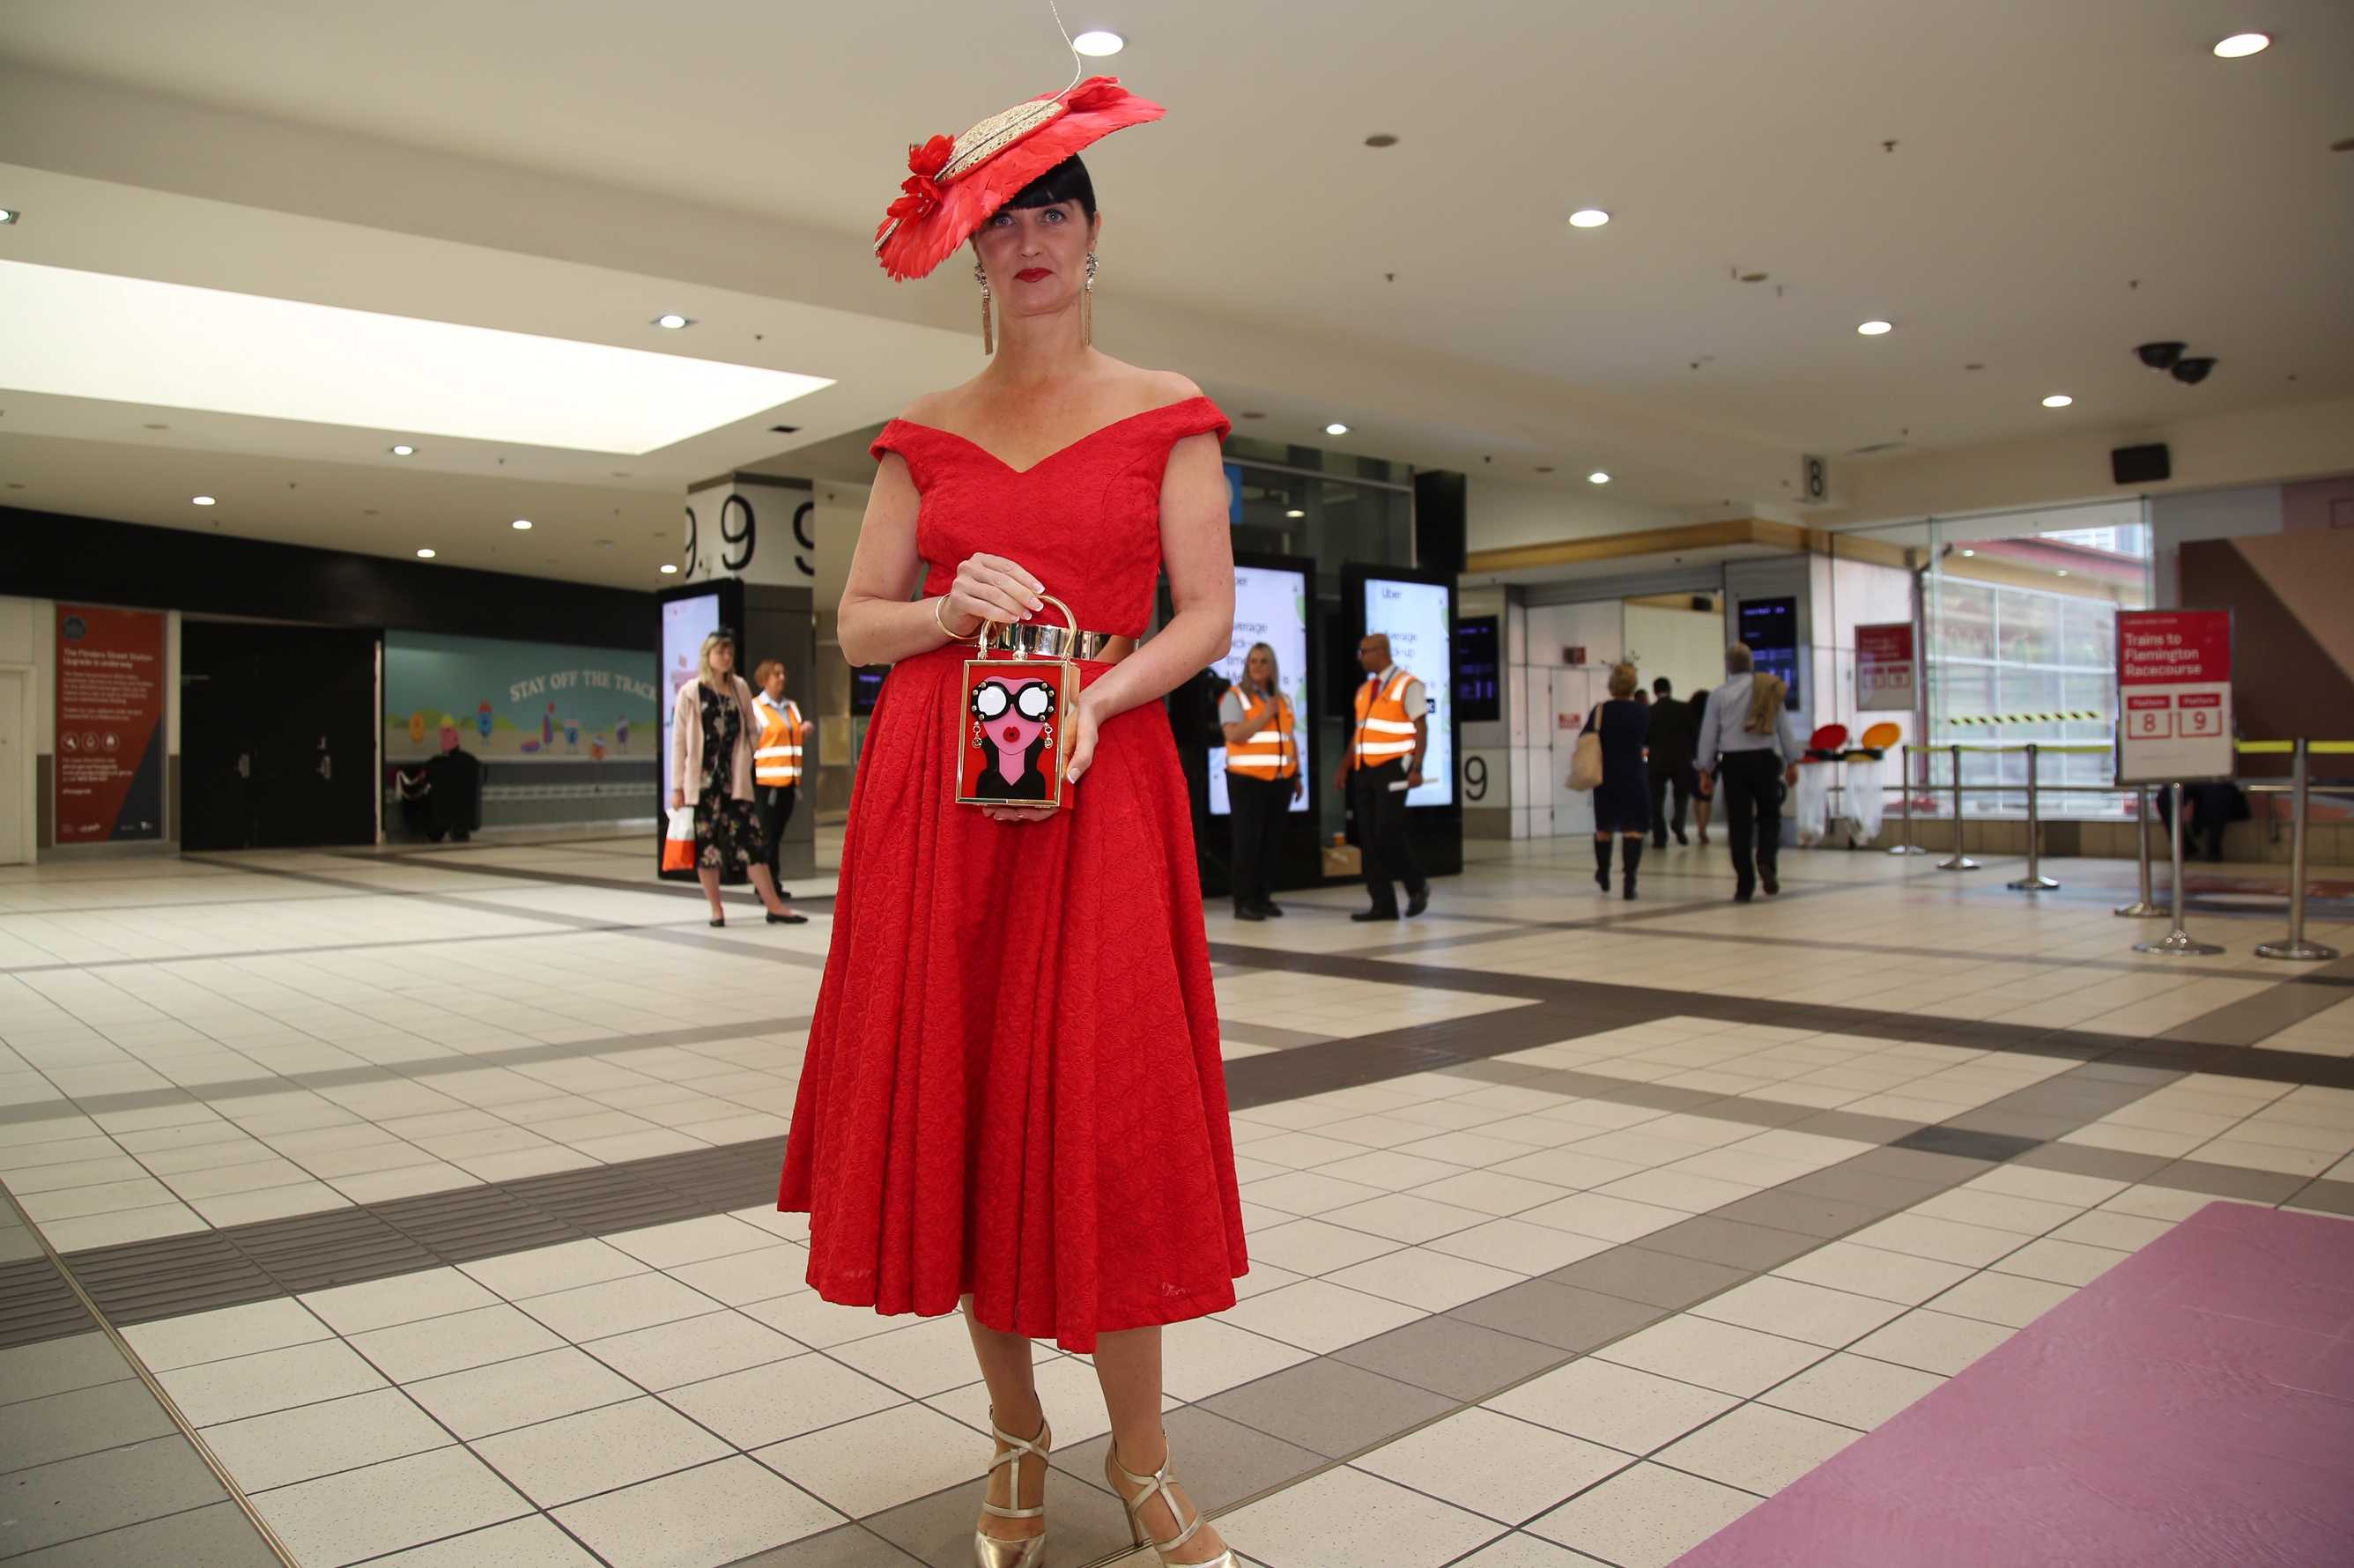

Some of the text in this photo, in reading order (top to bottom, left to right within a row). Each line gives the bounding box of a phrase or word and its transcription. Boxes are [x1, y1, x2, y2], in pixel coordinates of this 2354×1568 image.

[1810, 459, 1824, 498] 8
[721, 493, 756, 572] 9
[1381, 587, 1403, 600] Uber
[1233, 622, 1268, 635] verage
[2124, 632, 2182, 647] Trains to
[2124, 647, 2200, 663] Flemington
[2123, 662, 2202, 677] Racecourse
[510, 675, 546, 704] STAY
[549, 669, 579, 691] OFF
[581, 669, 612, 690] THE
[2142, 710, 2208, 733] 8 9
[1464, 755, 1488, 802] 9
